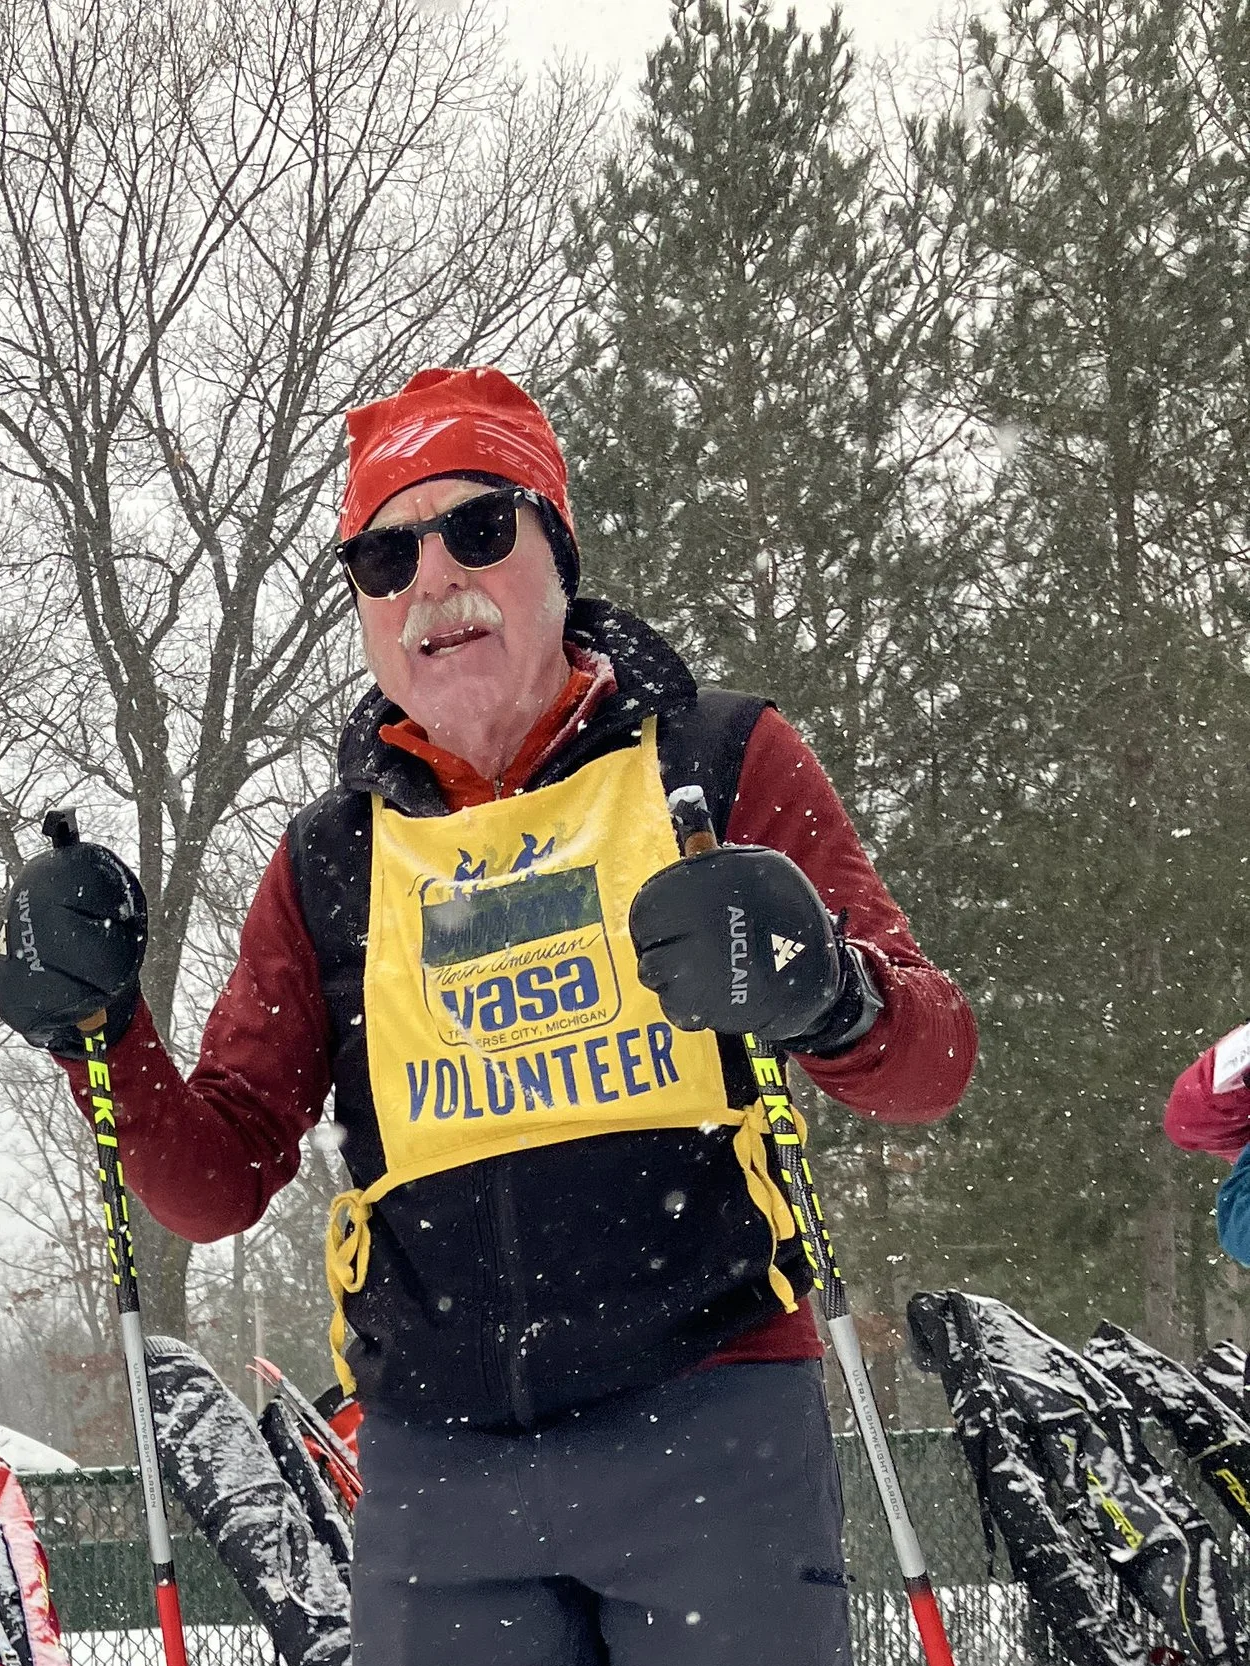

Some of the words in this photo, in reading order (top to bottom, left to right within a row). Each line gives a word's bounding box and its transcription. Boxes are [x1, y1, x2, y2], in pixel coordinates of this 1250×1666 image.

[16, 889, 46, 973] AUCLAIR
[491, 932, 602, 973] American
[727, 905, 749, 1005] AUCLAIR
[441, 955, 600, 1033] vasa
[546, 1009, 607, 1033] MICHIGAN
[405, 1021, 681, 1123] VOLUNTEER
[137, 1397, 152, 1463] LIGHTWEIGHT
[146, 1467, 157, 1508] CARBON
[852, 1369, 867, 1402] ULTRA
[862, 1405, 889, 1474] LIGHTWEIGHT
[883, 1477, 901, 1520] CARBON
